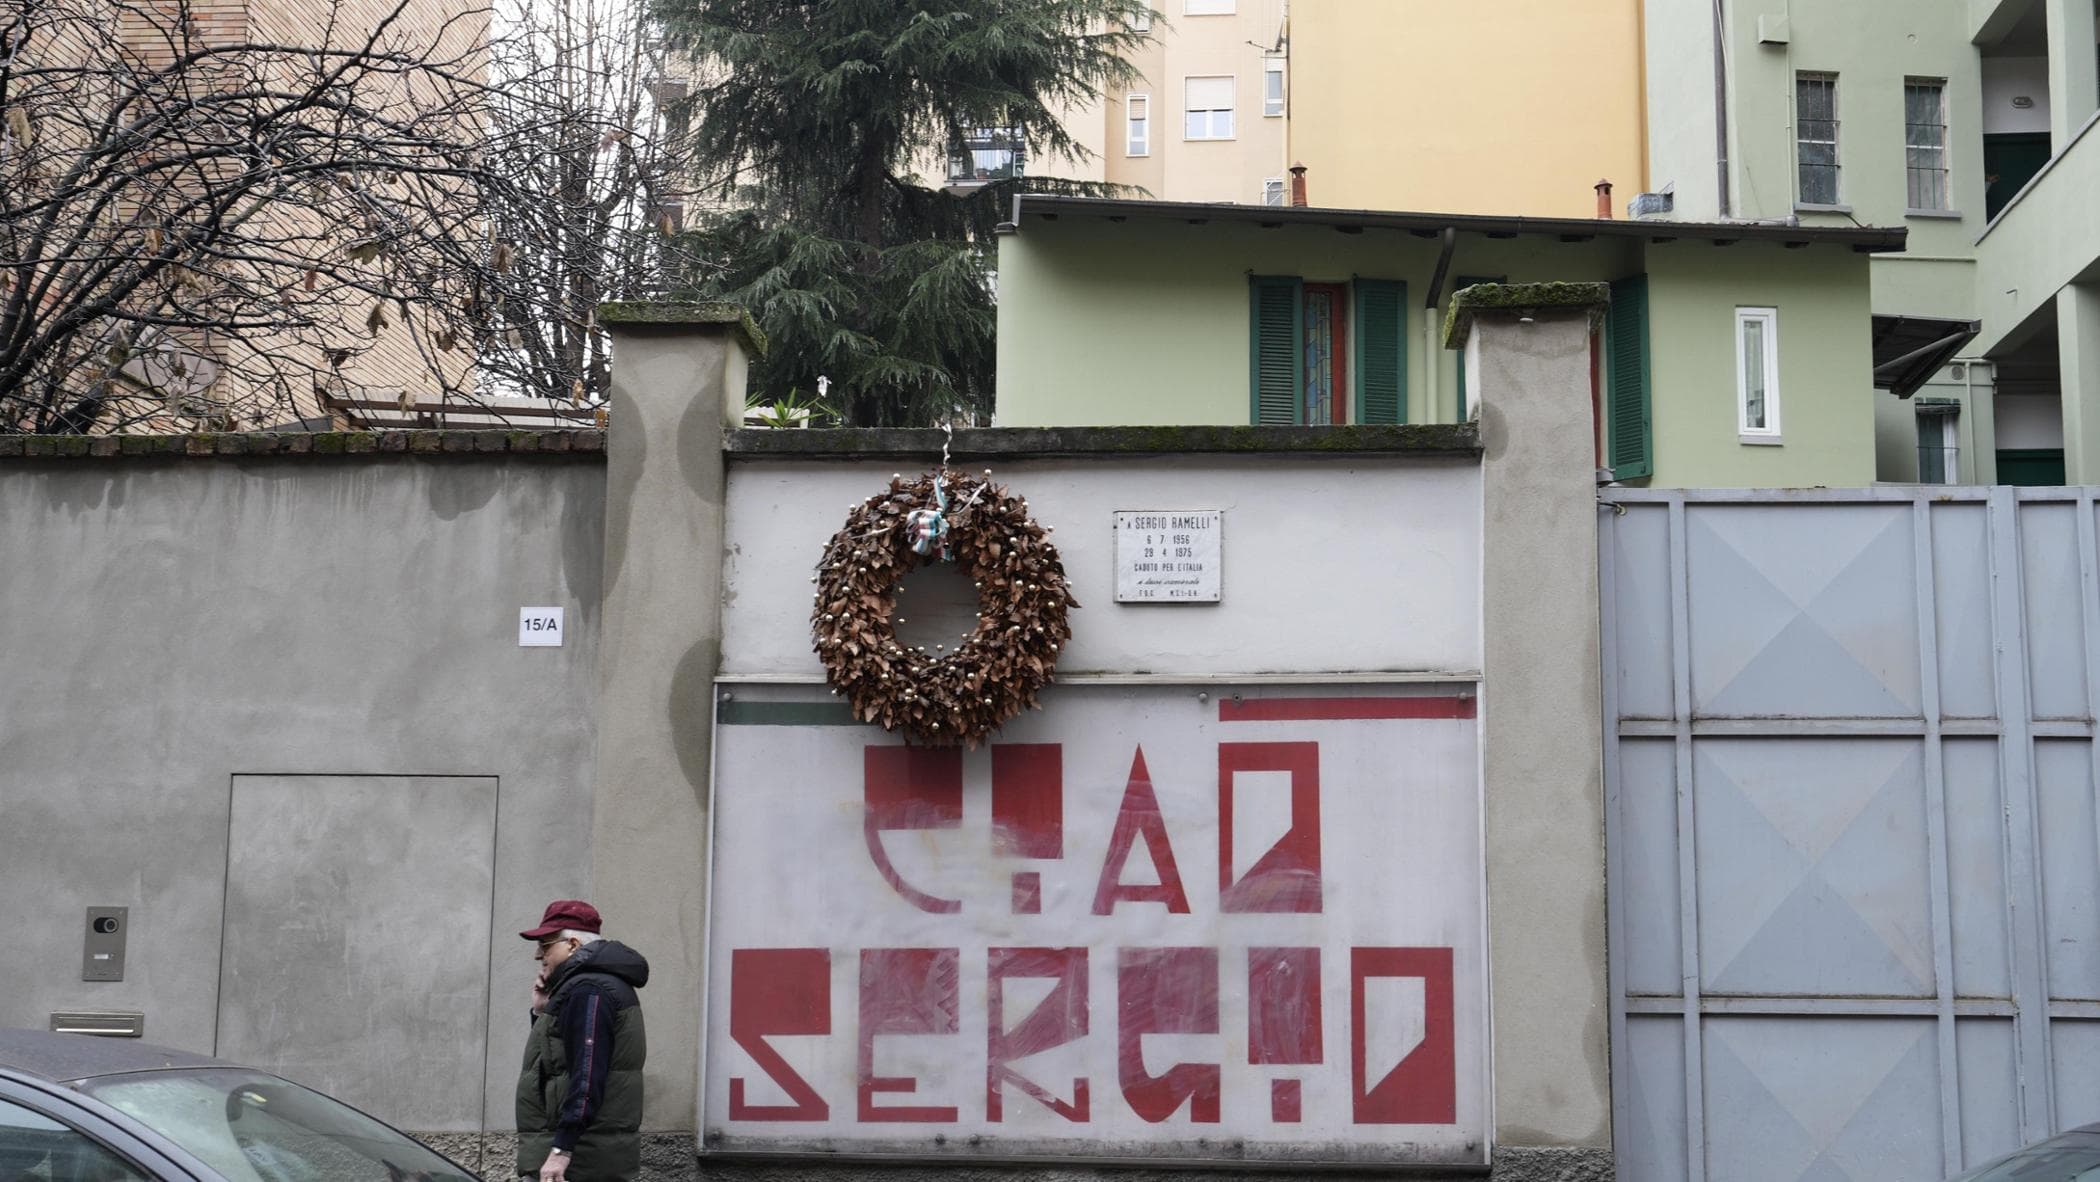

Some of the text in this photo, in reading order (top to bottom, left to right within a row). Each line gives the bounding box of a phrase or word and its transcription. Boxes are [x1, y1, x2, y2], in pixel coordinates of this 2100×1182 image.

[1135, 517, 1167, 529] SERGIO
[1171, 517, 1210, 529] RAMELLI
[1160, 535, 1165, 544] 7
[1173, 535, 1190, 544] 1956
[1162, 548, 1167, 557] 4
[1134, 563, 1158, 572] CADUTO
[1162, 563, 1174, 572] PER
[524, 617, 558, 631] 15/A
[864, 741, 1323, 915] CIAO
[729, 946, 1457, 1126] SERGIO
